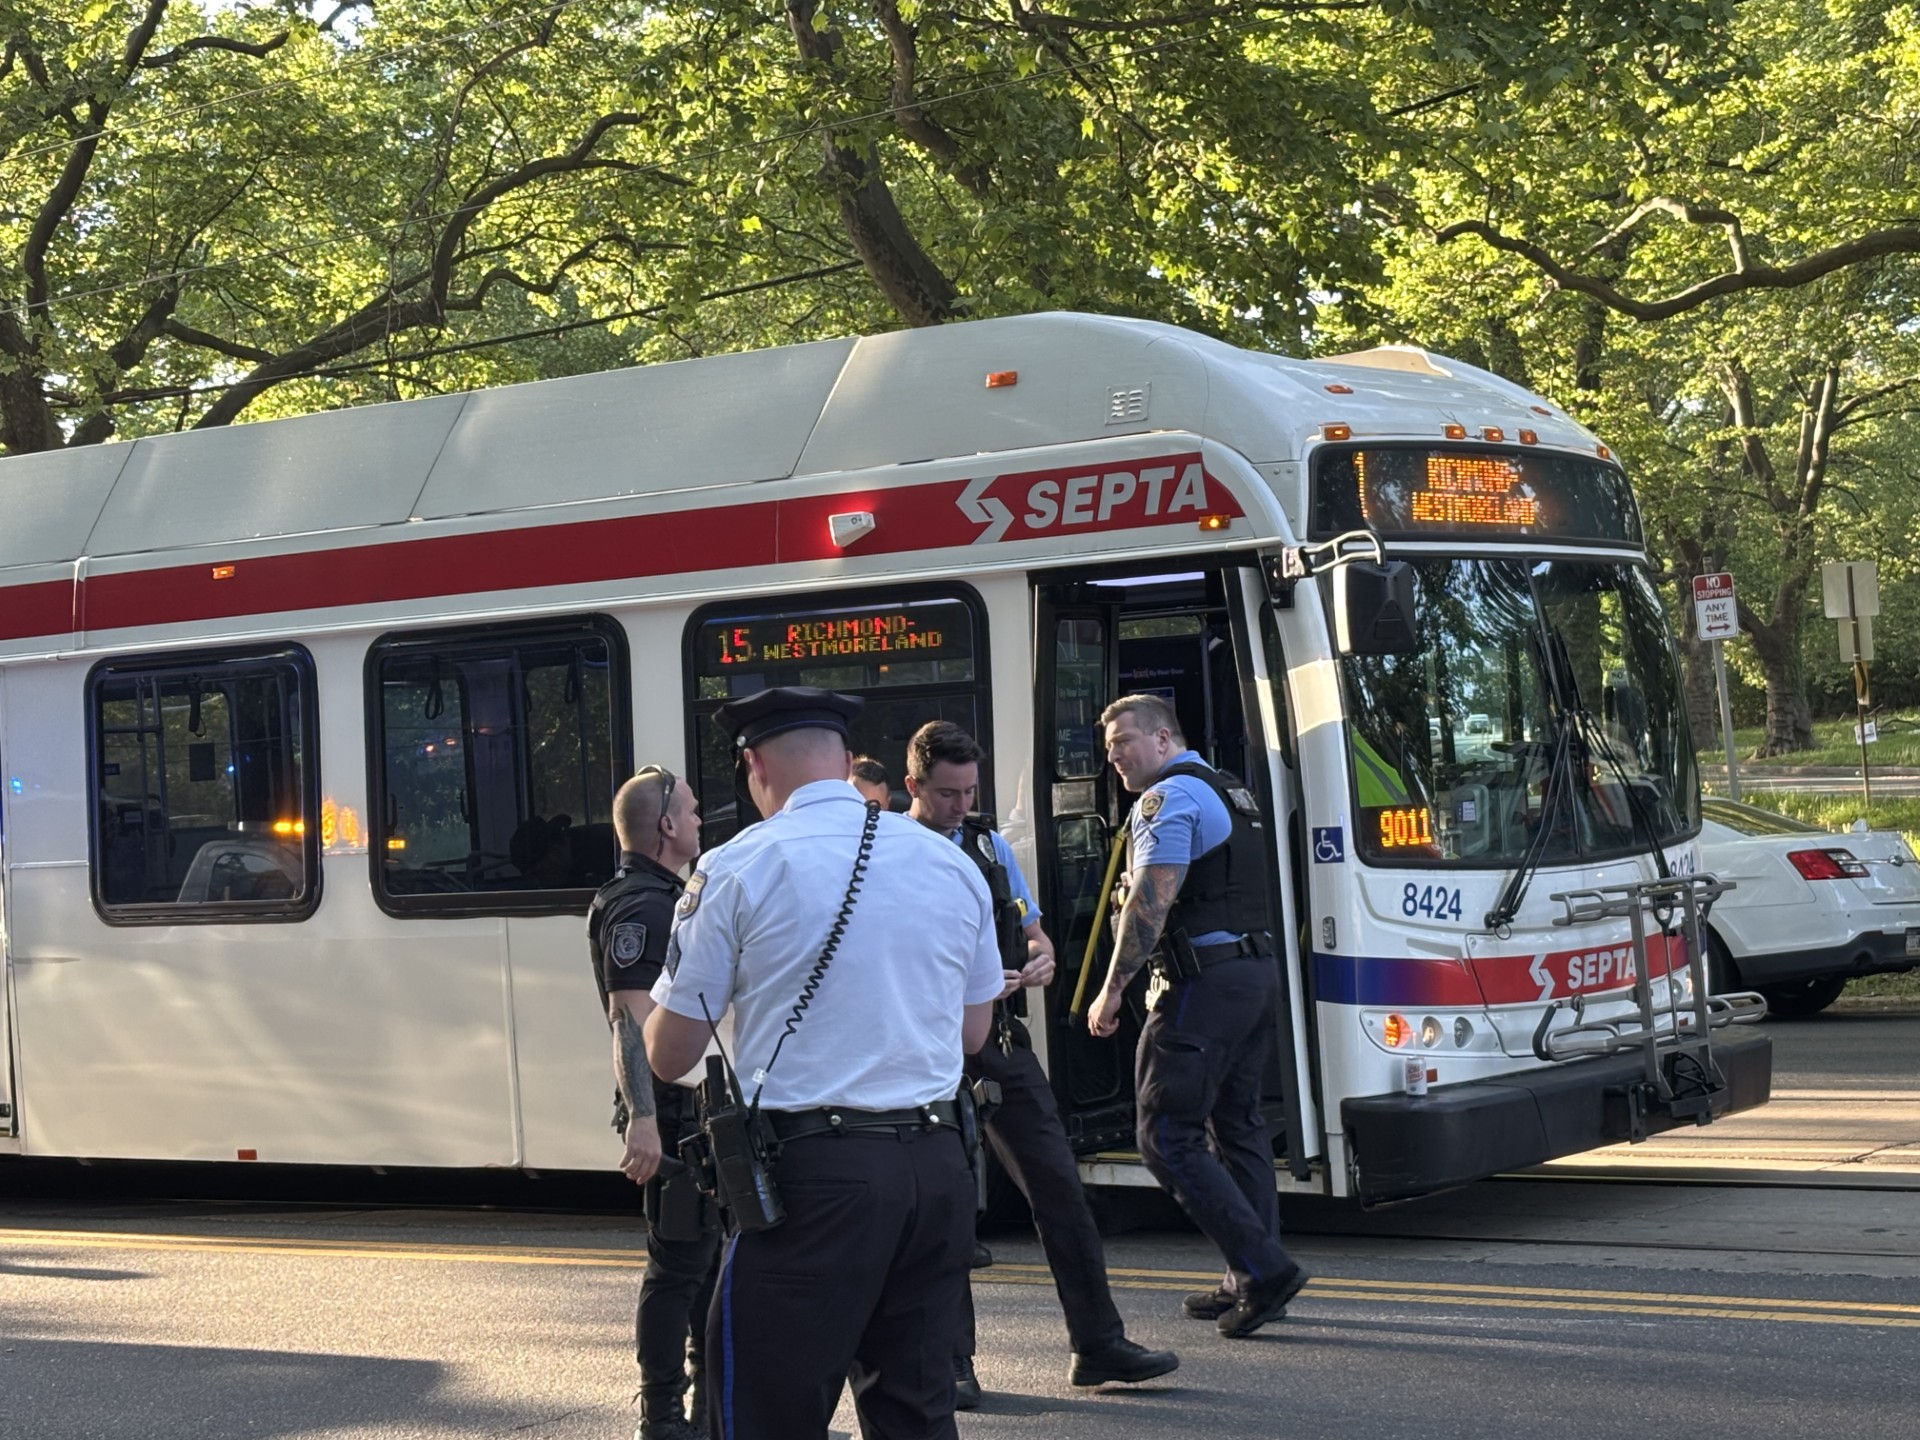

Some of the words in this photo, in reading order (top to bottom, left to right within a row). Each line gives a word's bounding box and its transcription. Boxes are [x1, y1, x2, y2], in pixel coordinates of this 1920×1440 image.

[1024, 463, 1208, 529] SEPTA
[1696, 587, 1732, 600] STOPPING
[1705, 576, 1721, 589] NO
[1705, 602, 1727, 613] ANY
[1705, 612, 1729, 622] TIME
[787, 614, 916, 643] RICHMOND-
[717, 628, 753, 664] 15
[762, 631, 943, 660] WESTMORELAND
[1380, 808, 1432, 848] 9011
[1402, 881, 1463, 922] 8424
[1567, 946, 1637, 990] SEPTA
